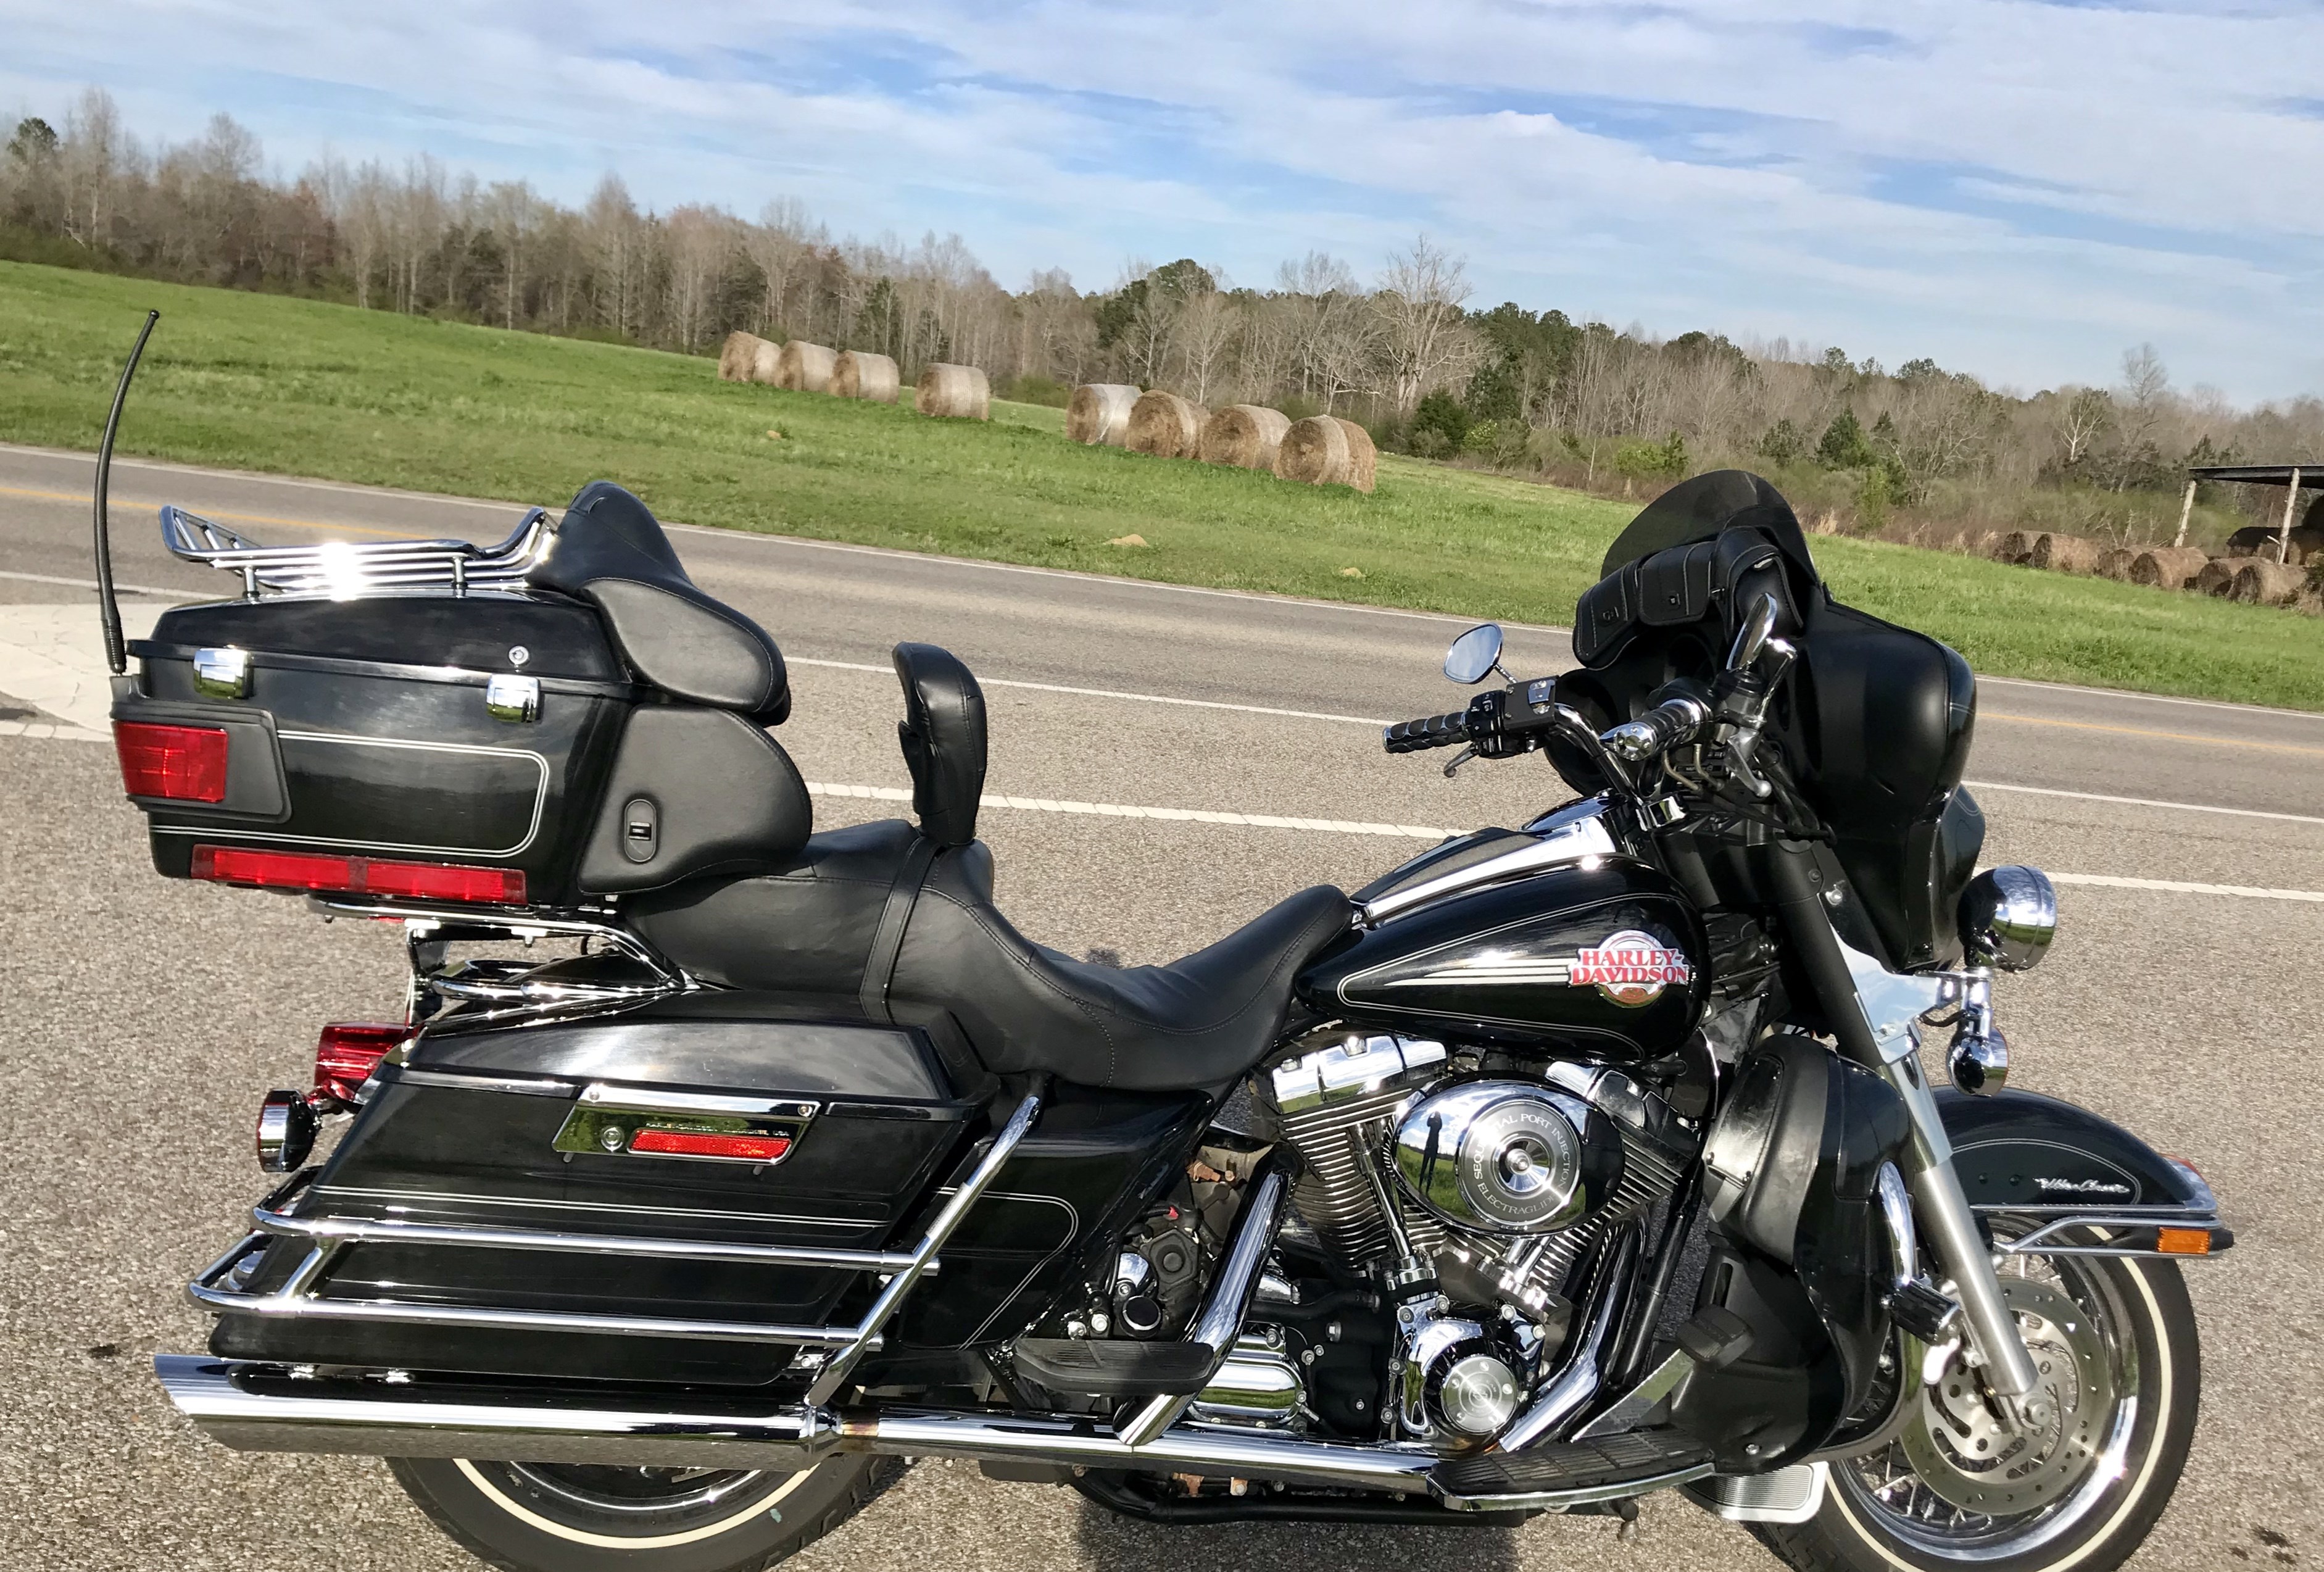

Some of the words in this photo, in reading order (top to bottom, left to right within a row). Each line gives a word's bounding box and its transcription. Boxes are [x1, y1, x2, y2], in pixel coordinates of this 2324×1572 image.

[1582, 950, 1683, 965] HARLEY-
[1572, 967, 1687, 983] DAVIDSON
[1474, 1115, 1518, 1179] SEQUIAL
[1521, 1113, 1552, 1129] PORT
[1551, 1128, 1570, 1189] INJECTION
